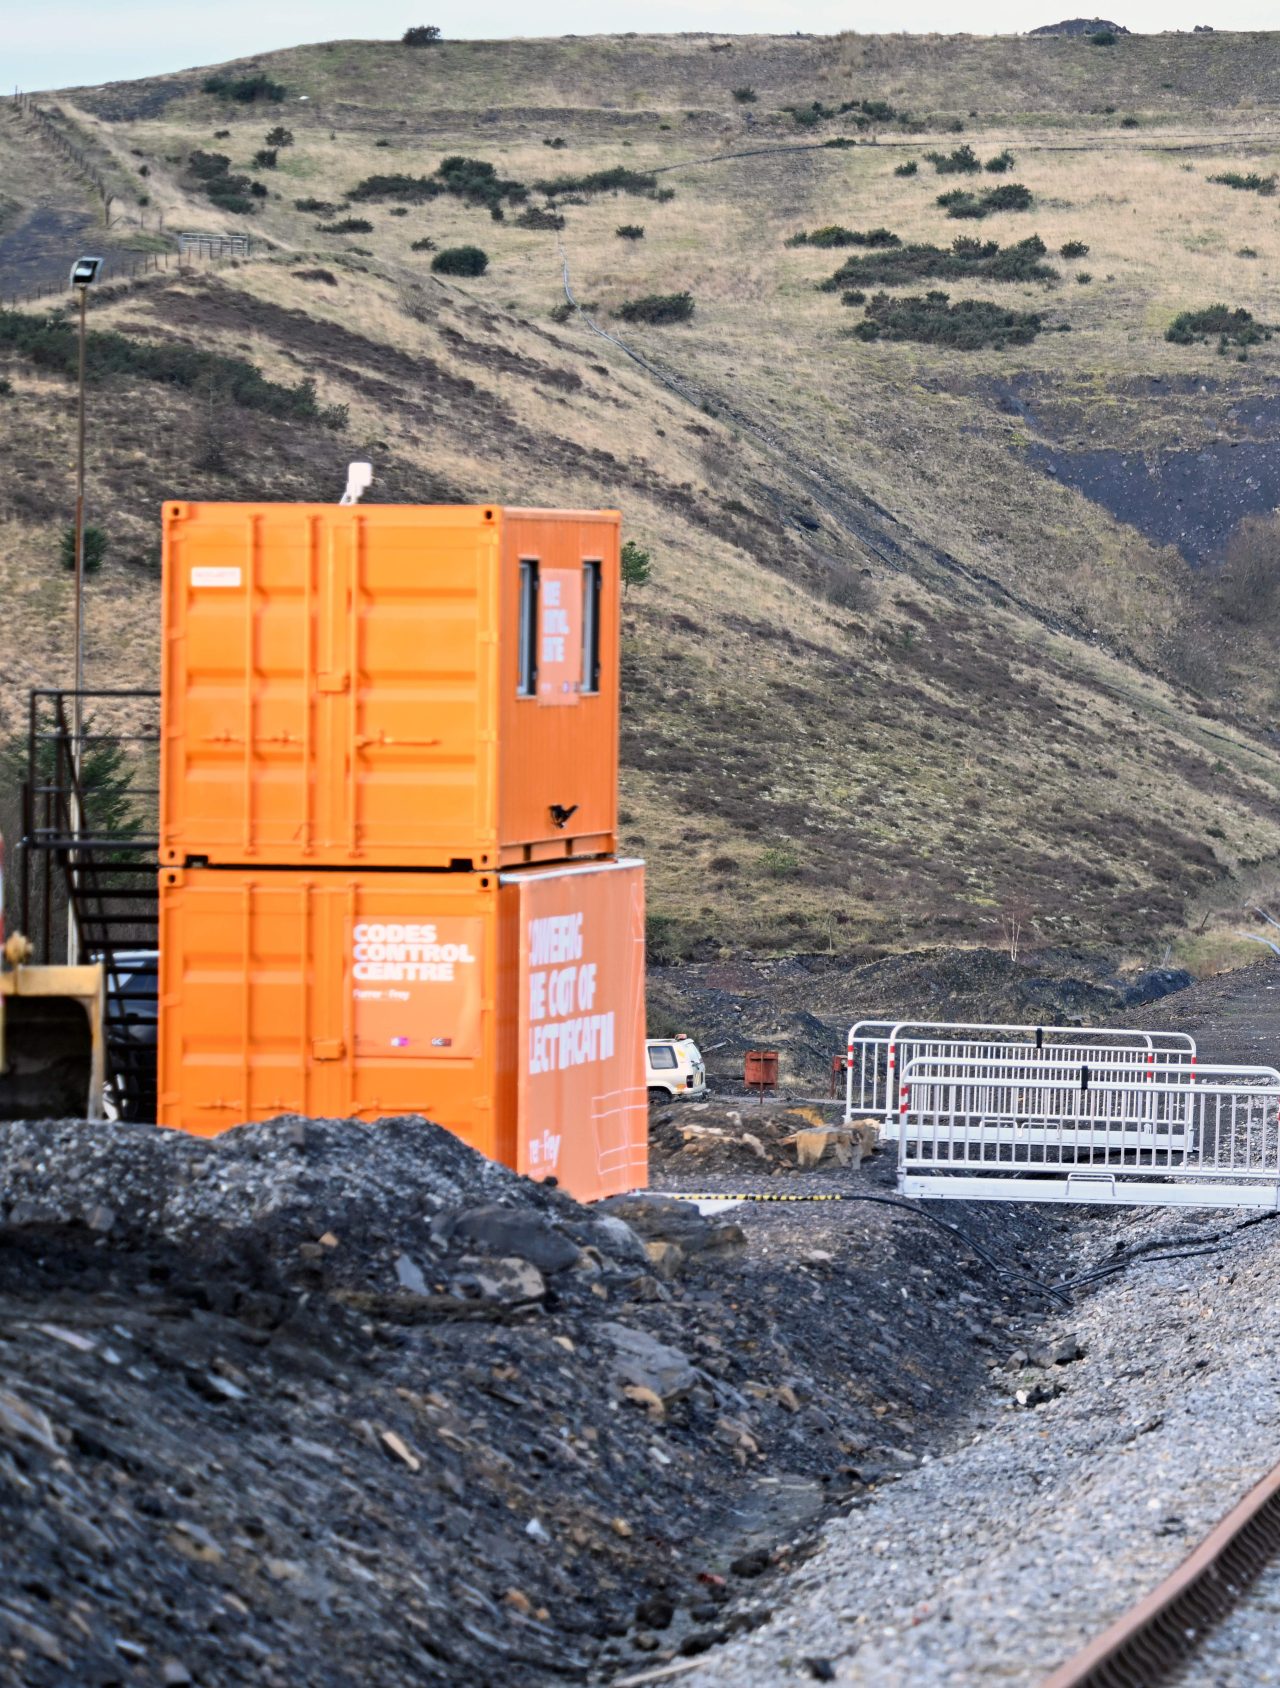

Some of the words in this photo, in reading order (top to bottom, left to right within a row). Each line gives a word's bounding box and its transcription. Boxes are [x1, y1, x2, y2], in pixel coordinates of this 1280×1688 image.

[354, 924, 437, 943] CODES
[354, 944, 475, 962] CONTROL
[353, 962, 454, 981] CENTRE
[578, 963, 597, 1011] OF
